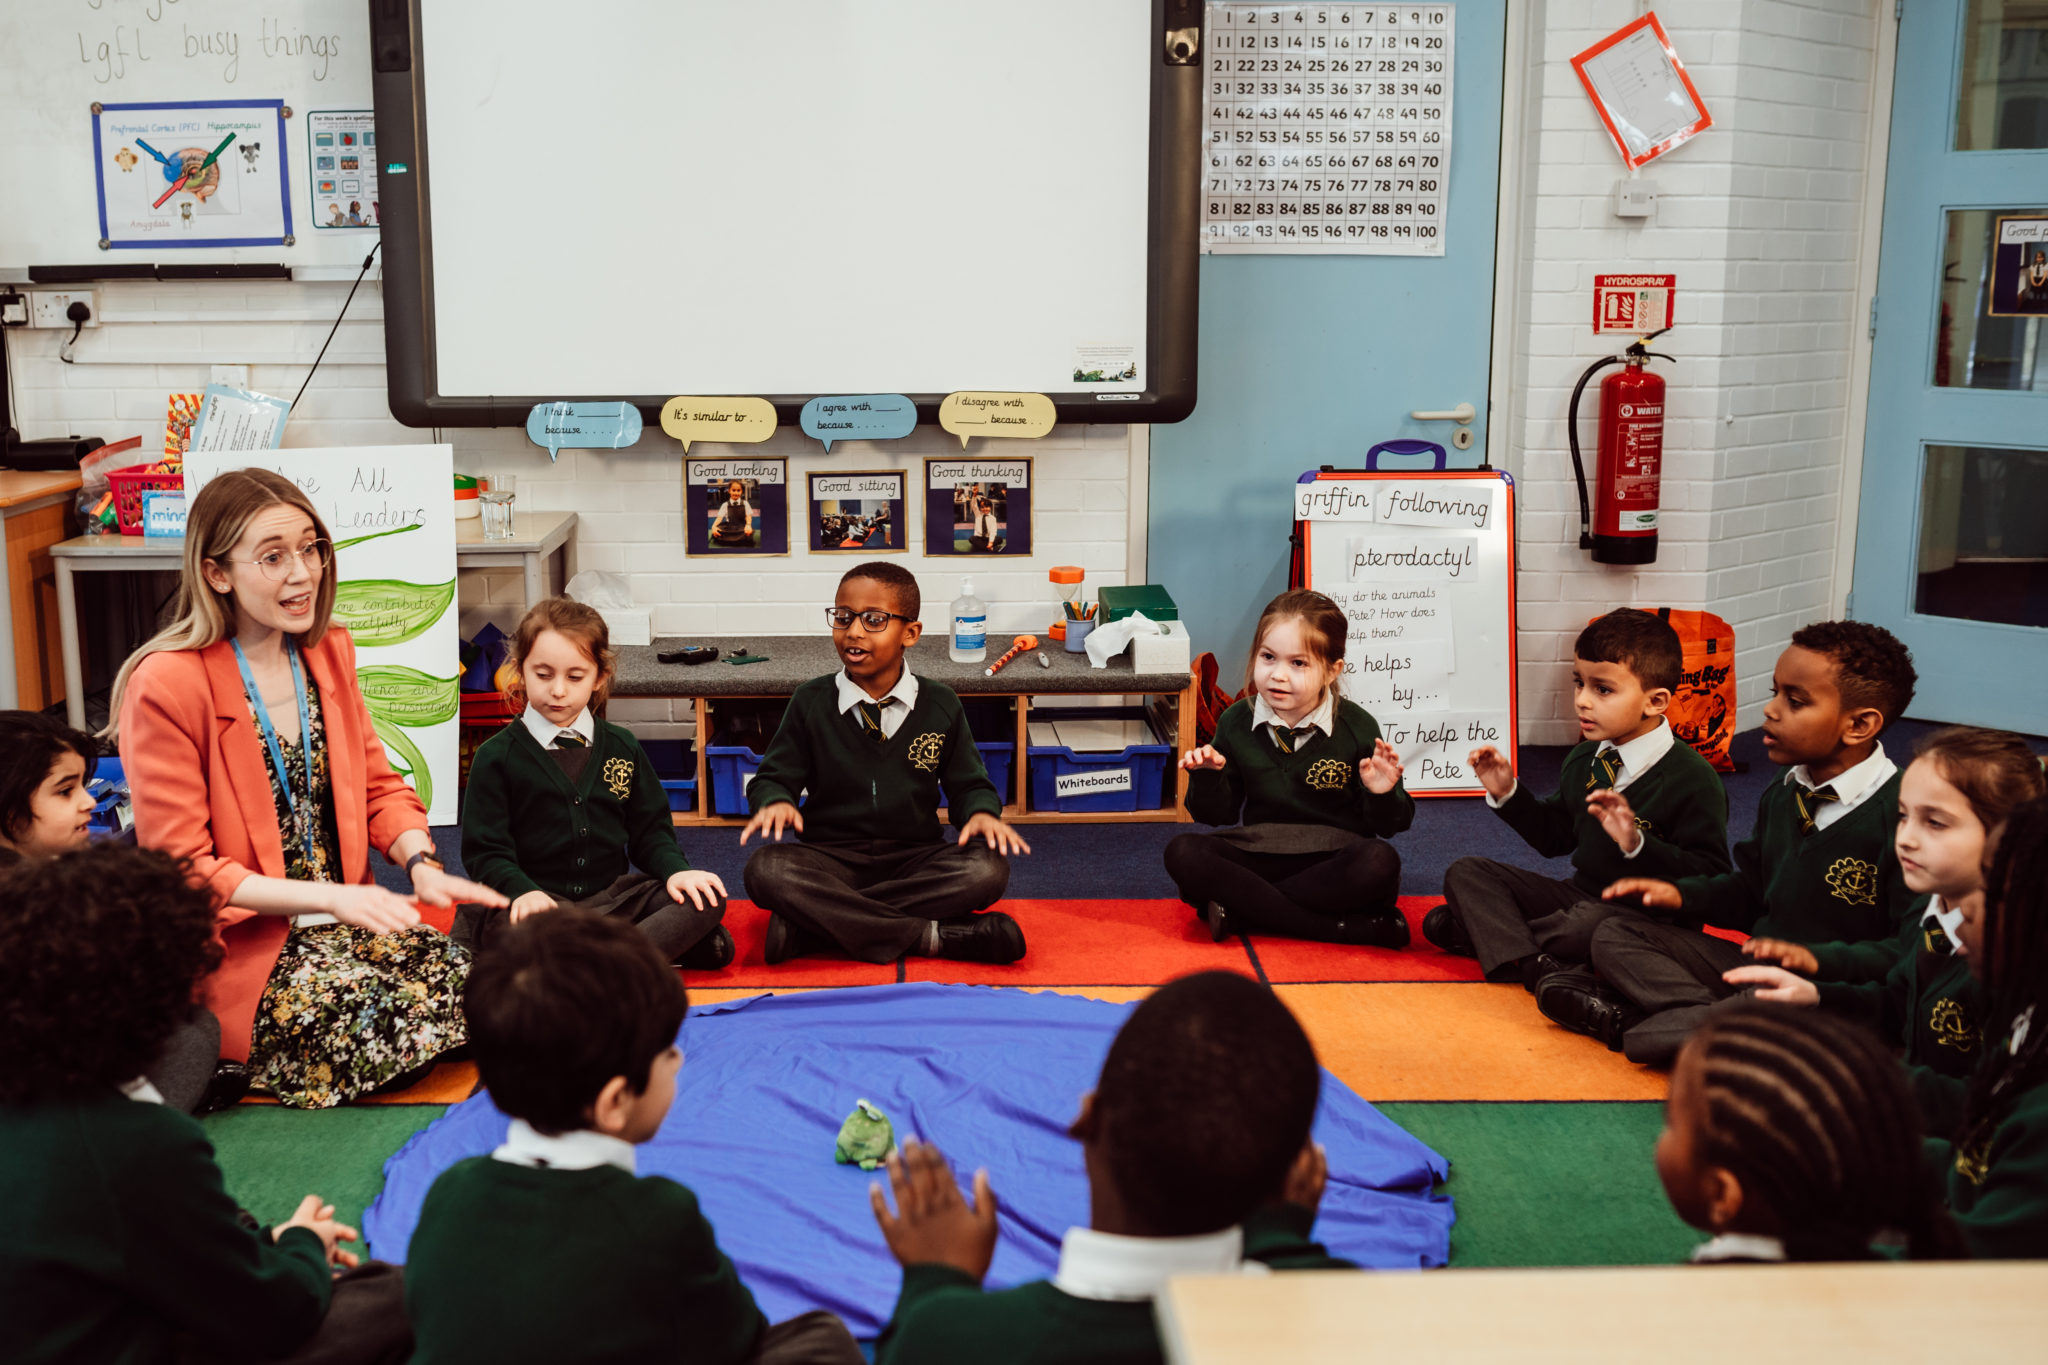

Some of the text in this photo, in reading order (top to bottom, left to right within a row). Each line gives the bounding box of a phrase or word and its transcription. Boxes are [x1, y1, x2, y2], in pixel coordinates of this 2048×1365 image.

[1247, 12, 1256, 24] 2
[1270, 12, 1279, 24] 3
[1294, 12, 1303, 23] 4
[1318, 12, 1326, 24] 5
[1341, 12, 1350, 23] 6
[1365, 12, 1374, 23] 7
[1411, 12, 1420, 24] 9
[1429, 13, 1443, 24] 10
[1217, 36, 1443, 49] 11 12 13 14 15 17 19 20
[184, 24, 239, 83] busy
[257, 18, 341, 81] things
[1214, 60, 1442, 72] 21 22 23 24 25 26 27 28 29 30
[1213, 82, 1442, 95] 31 32 33 34 35 36 38 39 40
[1213, 107, 1441, 120] 41 44 45 46 49 50
[1212, 131, 1416, 143] 51 52 53 54 55 56 58 59
[1235, 155, 1439, 168] 62 66 67 68 69 70
[1258, 179, 1437, 192] 73 74 75 76 77 78 79 80
[1210, 203, 1435, 215] 81 82 83 84 85 86 87 88 89 90
[1279, 225, 1437, 238] 94 95 96 97 98 99 100
[2006, 224, 2038, 237] Good
[1603, 276, 1667, 286] HYDROSPRAY
[822, 403, 848, 416] agree
[851, 401, 872, 411] with
[961, 396, 1000, 411] disagree
[1003, 397, 1024, 407] with
[673, 408, 747, 422] It's similar to
[990, 414, 1027, 425] because
[545, 424, 581, 434] because
[816, 420, 854, 430] because
[350, 466, 392, 493] All
[693, 463, 778, 482] Good looking
[931, 464, 1024, 484] Good thinking
[818, 478, 896, 497] Good sitting
[151, 507, 186, 522] mind
[334, 500, 426, 528] Leaders
[1299, 486, 1489, 528] griffin following
[1352, 545, 1472, 577] pterodactyl
[1352, 591, 1369, 602] do
[1371, 589, 1388, 601] the
[1391, 586, 1436, 600] animals
[1348, 606, 1436, 621] Pete? How does
[350, 615, 408, 636] pectfully
[1371, 625, 1404, 639] them?
[1364, 652, 1412, 680] helps
[1382, 720, 1500, 752] To help the
[1420, 758, 1463, 780] Pete
[1058, 773, 1129, 790] Whiteboards
